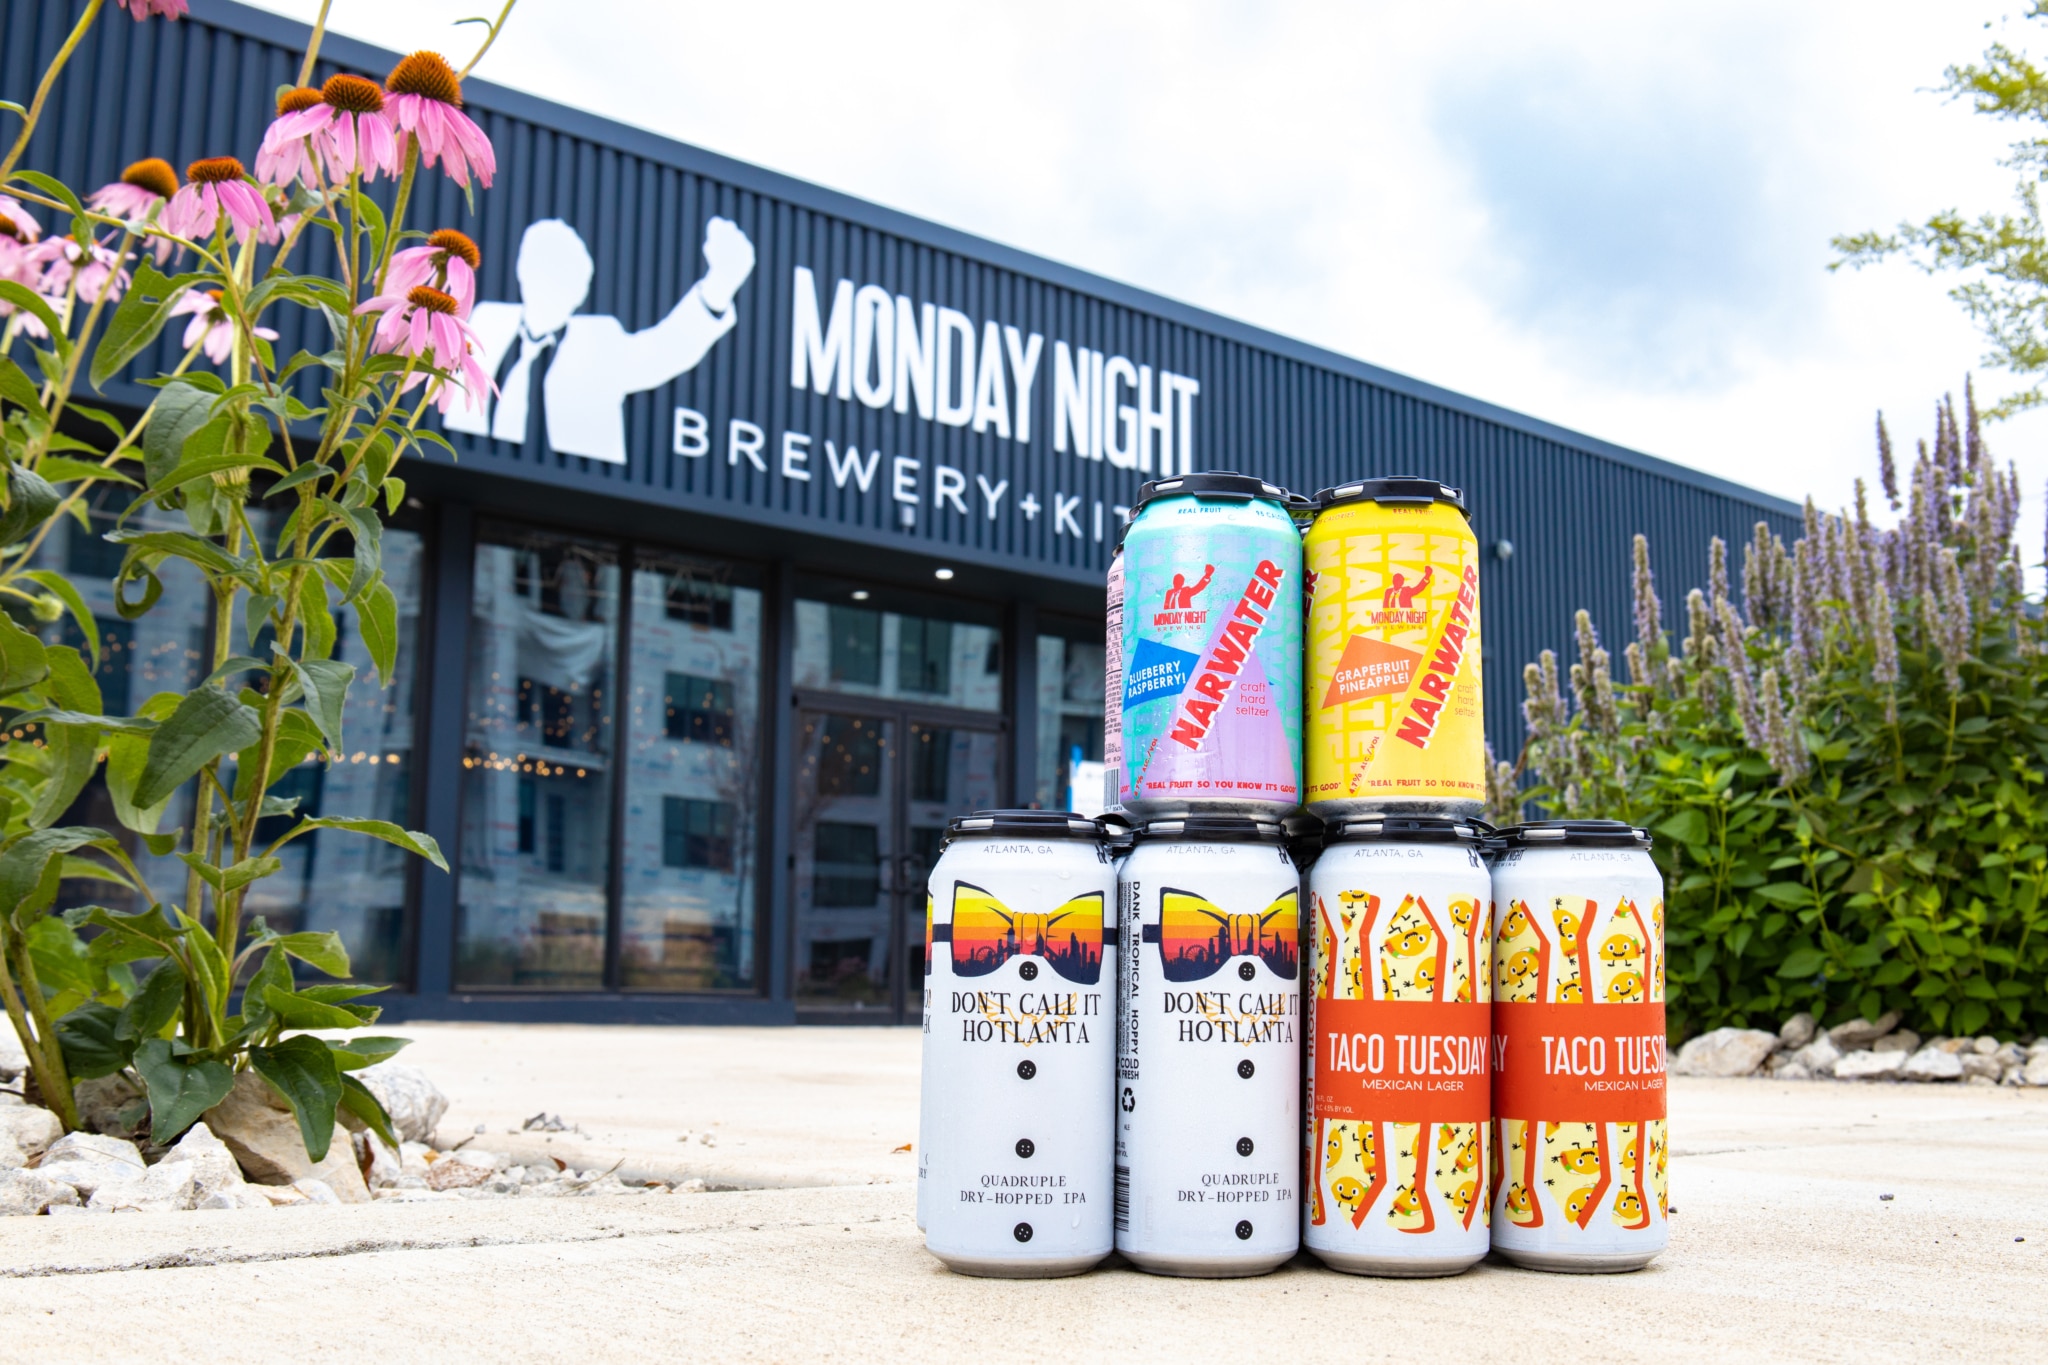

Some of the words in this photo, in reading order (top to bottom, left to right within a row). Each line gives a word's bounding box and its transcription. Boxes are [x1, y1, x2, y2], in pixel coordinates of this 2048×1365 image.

[791, 265, 1043, 444] MONDAY
[1055, 340, 1200, 476] NIGHT
[1153, 611, 1183, 626] MONDAY
[1184, 611, 1207, 624] NIGHT
[1371, 611, 1404, 624] MONDAY
[1405, 610, 1428, 624] NIGHT
[1170, 559, 1286, 751] NARWATER
[1395, 564, 1478, 750] NARWATER
[1129, 660, 1181, 686] BLUEBERRY
[1335, 659, 1410, 683] GRAPEFRUIT
[1128, 672, 1186, 699] RASPBERRY!
[1240, 682, 1266, 692] craft
[1339, 672, 1409, 695] PINEAPPLE!
[1240, 693, 1265, 705] hard
[1457, 694, 1474, 706] hard
[1235, 705, 1270, 717] seltzer
[1169, 781, 1193, 789] FRUIT
[1237, 781, 1262, 790] KNOW
[1397, 779, 1421, 787] FRUIT
[1441, 780, 1456, 788] YOU
[1458, 781, 1475, 789] KNOW
[1037, 846, 1054, 855] GA
[1219, 847, 1237, 855] GA
[1407, 849, 1424, 858] GA
[1620, 853, 1634, 862] GA
[1132, 880, 1141, 921] DANK
[1131, 931, 1140, 1000] TROPICAL
[951, 991, 1011, 1016] DON'T
[1019, 992, 1077, 1016] CALL
[1083, 993, 1102, 1017] IT
[1164, 991, 1231, 1016] DON'T
[1238, 992, 1287, 1016] CALL
[1288, 993, 1299, 1017] IT
[1308, 967, 1316, 1058] SMOOTH
[962, 1019, 1090, 1044] HOTLANTA
[1131, 1009, 1139, 1055] HOPPY
[1178, 1019, 1294, 1044] HOTLANTA
[1328, 1033, 1385, 1073] TACO
[1395, 1034, 1487, 1076] TUESDAY
[1541, 1036, 1606, 1076] TACO
[1614, 1034, 1667, 1075] TUESD
[1120, 1057, 1140, 1069] COLD
[1121, 1069, 1140, 1080] FRESH
[1362, 1079, 1423, 1091] MEXICAN
[1427, 1080, 1465, 1092] LAGER
[1584, 1079, 1639, 1092] MEXICAN
[1641, 1078, 1664, 1090] LAGER
[1334, 1105, 1342, 1113] BY
[981, 1174, 1067, 1188] QUADRUPLE
[1201, 1172, 1280, 1187] QUADRUPLE
[960, 1190, 1053, 1205] DRY-HOPPED
[1063, 1191, 1087, 1205] IPA
[1178, 1190, 1270, 1203] DRY-HOPPED
[1276, 1188, 1293, 1201] IPA
